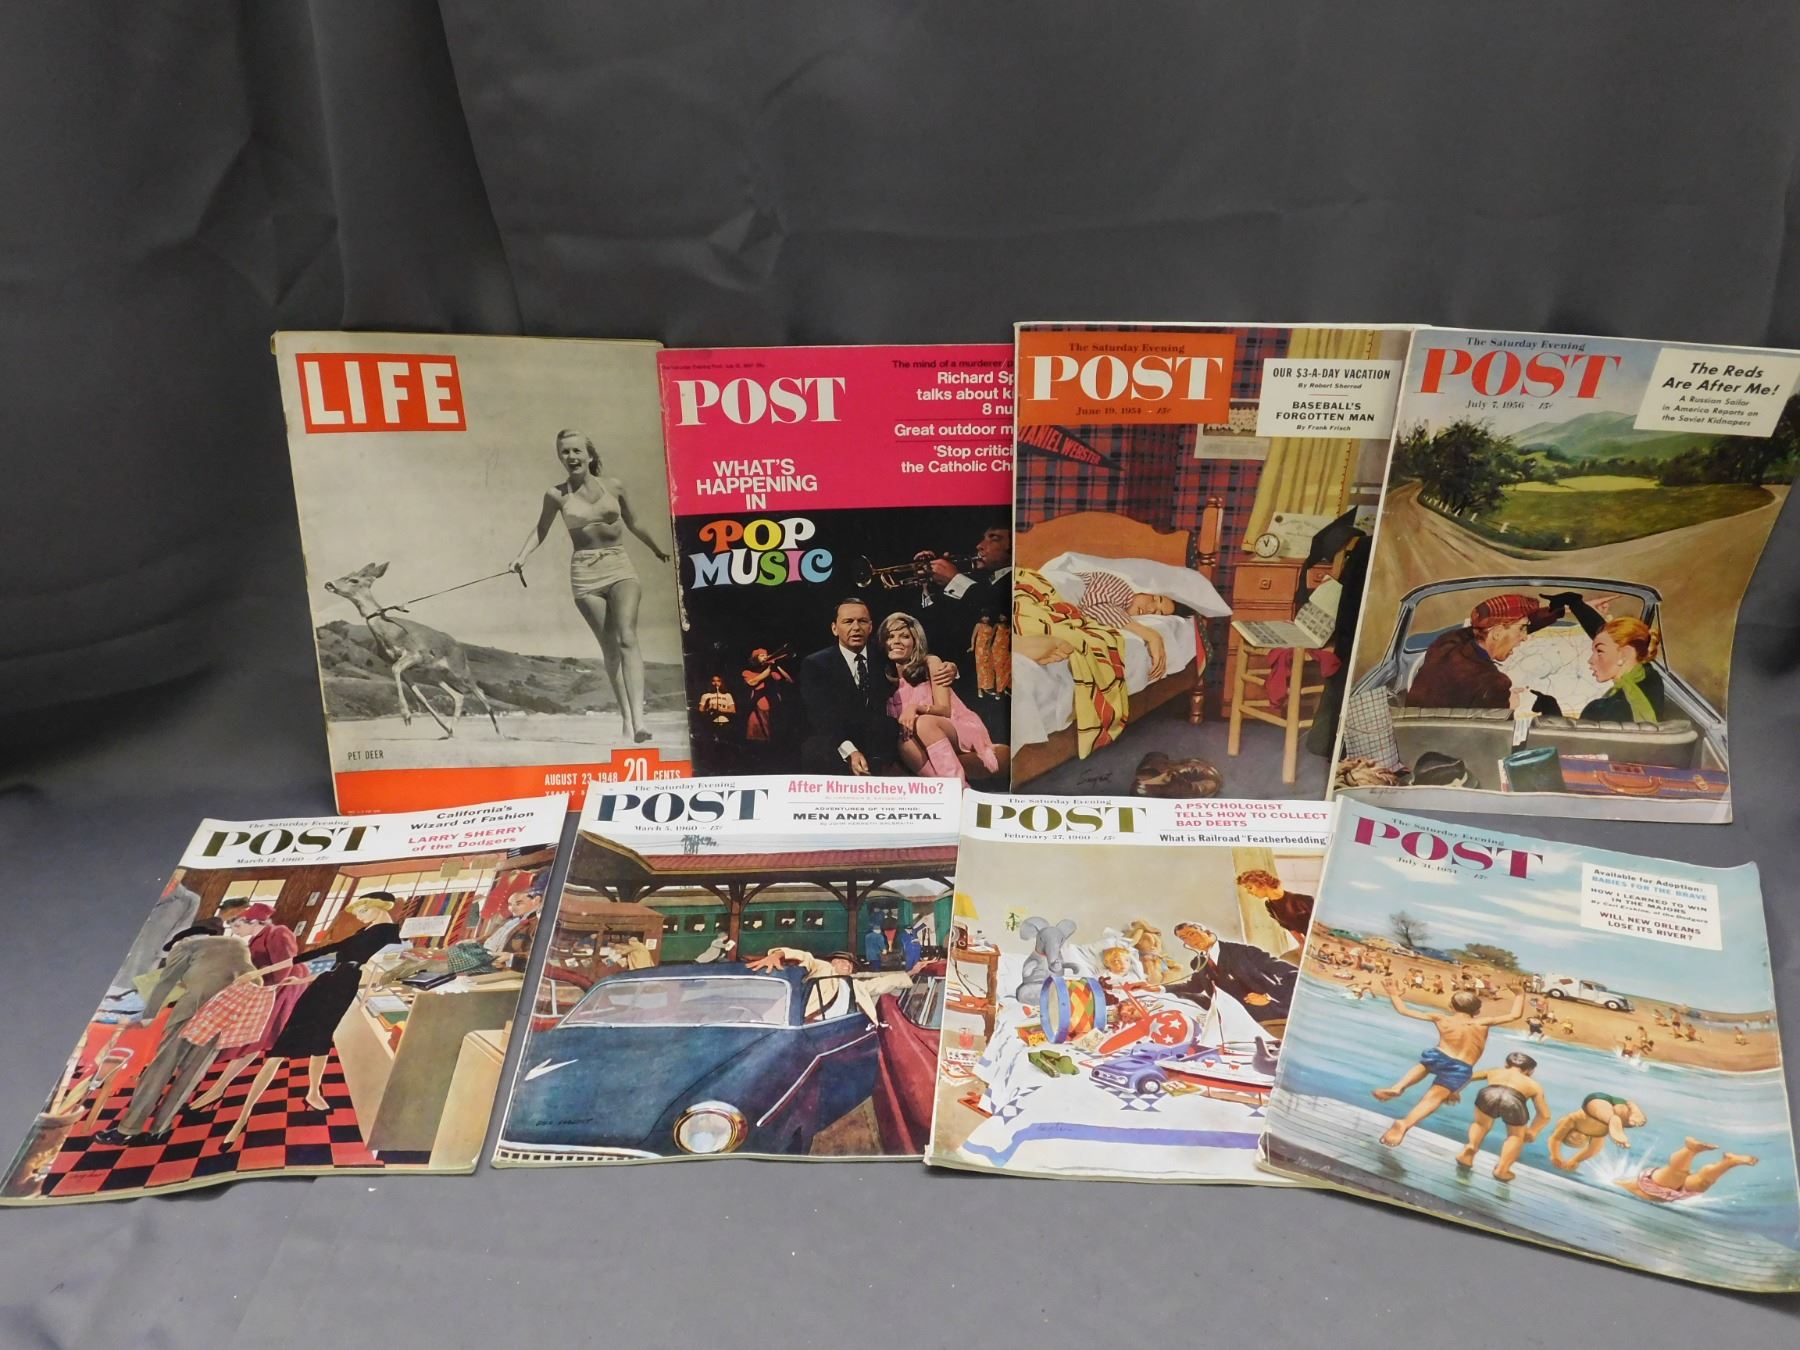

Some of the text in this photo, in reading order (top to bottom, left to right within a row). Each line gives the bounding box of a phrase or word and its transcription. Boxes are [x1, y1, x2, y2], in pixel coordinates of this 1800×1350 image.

[1069, 343, 1185, 354] The Saturday Evening
[1466, 337, 1586, 352] The Saturday Evening
[892, 360, 910, 368] The
[913, 360, 936, 368] mind
[940, 360, 949, 368] of
[959, 360, 1002, 368] murderer
[1690, 362, 1764, 379] The Reds
[937, 371, 994, 384] Richard
[1026, 354, 1224, 401] POST
[1272, 367, 1391, 380] OUR $3-A-DAY VACATION
[1414, 347, 1622, 399] POST
[303, 360, 459, 424] LIFE
[917, 388, 952, 400] talks
[956, 387, 998, 400] about
[1662, 376, 1780, 396] Are After Me!
[672, 377, 846, 426] POST
[982, 402, 992, 415] 8
[1292, 401, 1362, 410] BASEBALL'S
[1465, 400, 1486, 409] July
[1689, 396, 1721, 404] Russian
[1725, 398, 1750, 406] Sailor
[1075, 407, 1101, 416] June
[1275, 412, 1375, 422] FORGOTTEN MAN
[1673, 405, 1710, 414] America
[1712, 407, 1745, 416] Reports
[1662, 414, 1751, 427] the Soviet Kidnapers
[894, 424, 935, 436] Great
[939, 423, 996, 436] outdoor
[713, 458, 796, 477] WHAT'S
[901, 461, 924, 472] the
[928, 460, 987, 472] Catholic
[696, 475, 818, 496] HAPPENING
[745, 494, 767, 510] IN
[698, 517, 816, 554] POP
[688, 548, 833, 590] MUSIC
[347, 749, 384, 760] PET DEER
[544, 772, 578, 786] AUGUST
[598, 772, 618, 783] 1948
[623, 757, 648, 782] 20
[653, 769, 681, 780] CENTS
[654, 783, 694, 791] Saturday
[698, 781, 736, 789] Evening
[788, 780, 944, 796] After Khrushchev, Who?
[436, 805, 513, 819] California's
[594, 788, 769, 823] POST
[1186, 802, 1283, 810] PSYCHOLOGIST
[249, 819, 349, 828] The Saturday Evening
[410, 819, 459, 830] Wizard
[481, 811, 535, 823] Fashion
[974, 803, 1147, 833] POST
[1270, 812, 1328, 820] COLLECT
[407, 825, 527, 844] LARRY SHERRY
[1159, 834, 1184, 842] What
[1187, 834, 1196, 842] is
[1198, 834, 1241, 842] Railroad
[1391, 817, 1506, 847] The Saturday Evening
[198, 824, 381, 857] POST
[457, 836, 517, 848] Dodgers
[1350, 814, 1544, 881] POST
[1593, 868, 1636, 881] Available
[1591, 876, 1708, 900] BABIES FOR THE BRAVE
[1590, 887, 1613, 896] HOW
[1623, 893, 1668, 905] LEARNED
[1687, 904, 1708, 912] WIN
[1625, 899, 1643, 907] THE
[1647, 903, 1687, 915] MAJORS
[1600, 911, 1701, 935] WILL NEW ORLEANS
[1608, 920, 1693, 941] LOSE ITS RIVER?
